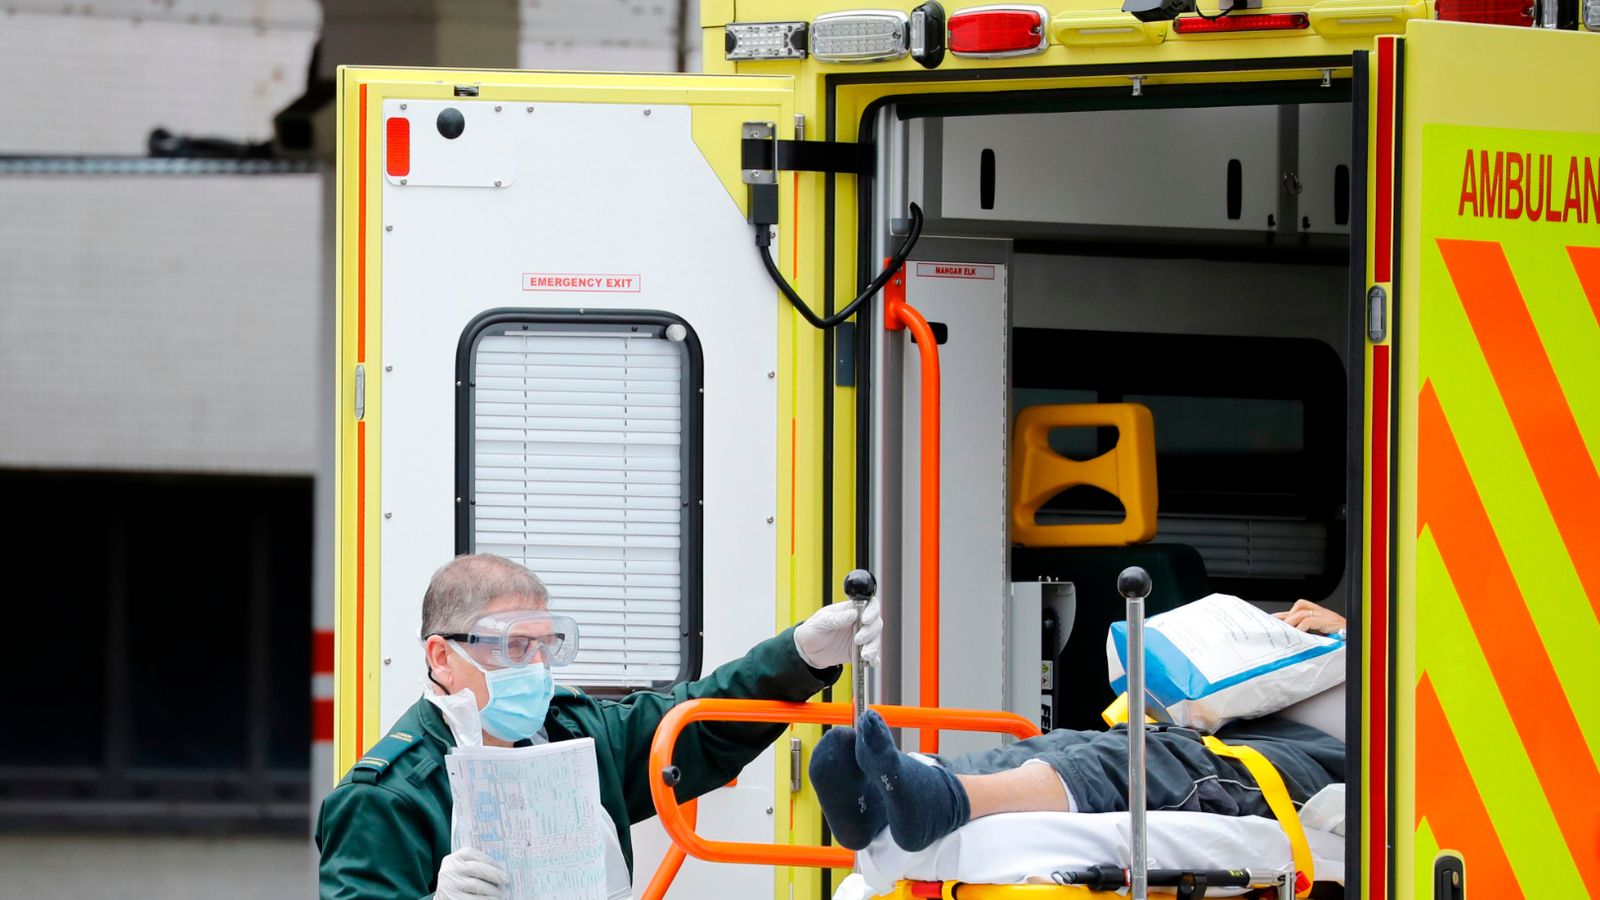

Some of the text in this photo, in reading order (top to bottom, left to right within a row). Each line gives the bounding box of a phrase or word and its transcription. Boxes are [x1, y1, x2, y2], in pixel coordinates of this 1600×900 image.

[1458, 149, 1600, 224] AMBULAN
[935, 265, 977, 276] MANGAR ELK
[530, 277, 633, 288] EMERGENCY EXIT
